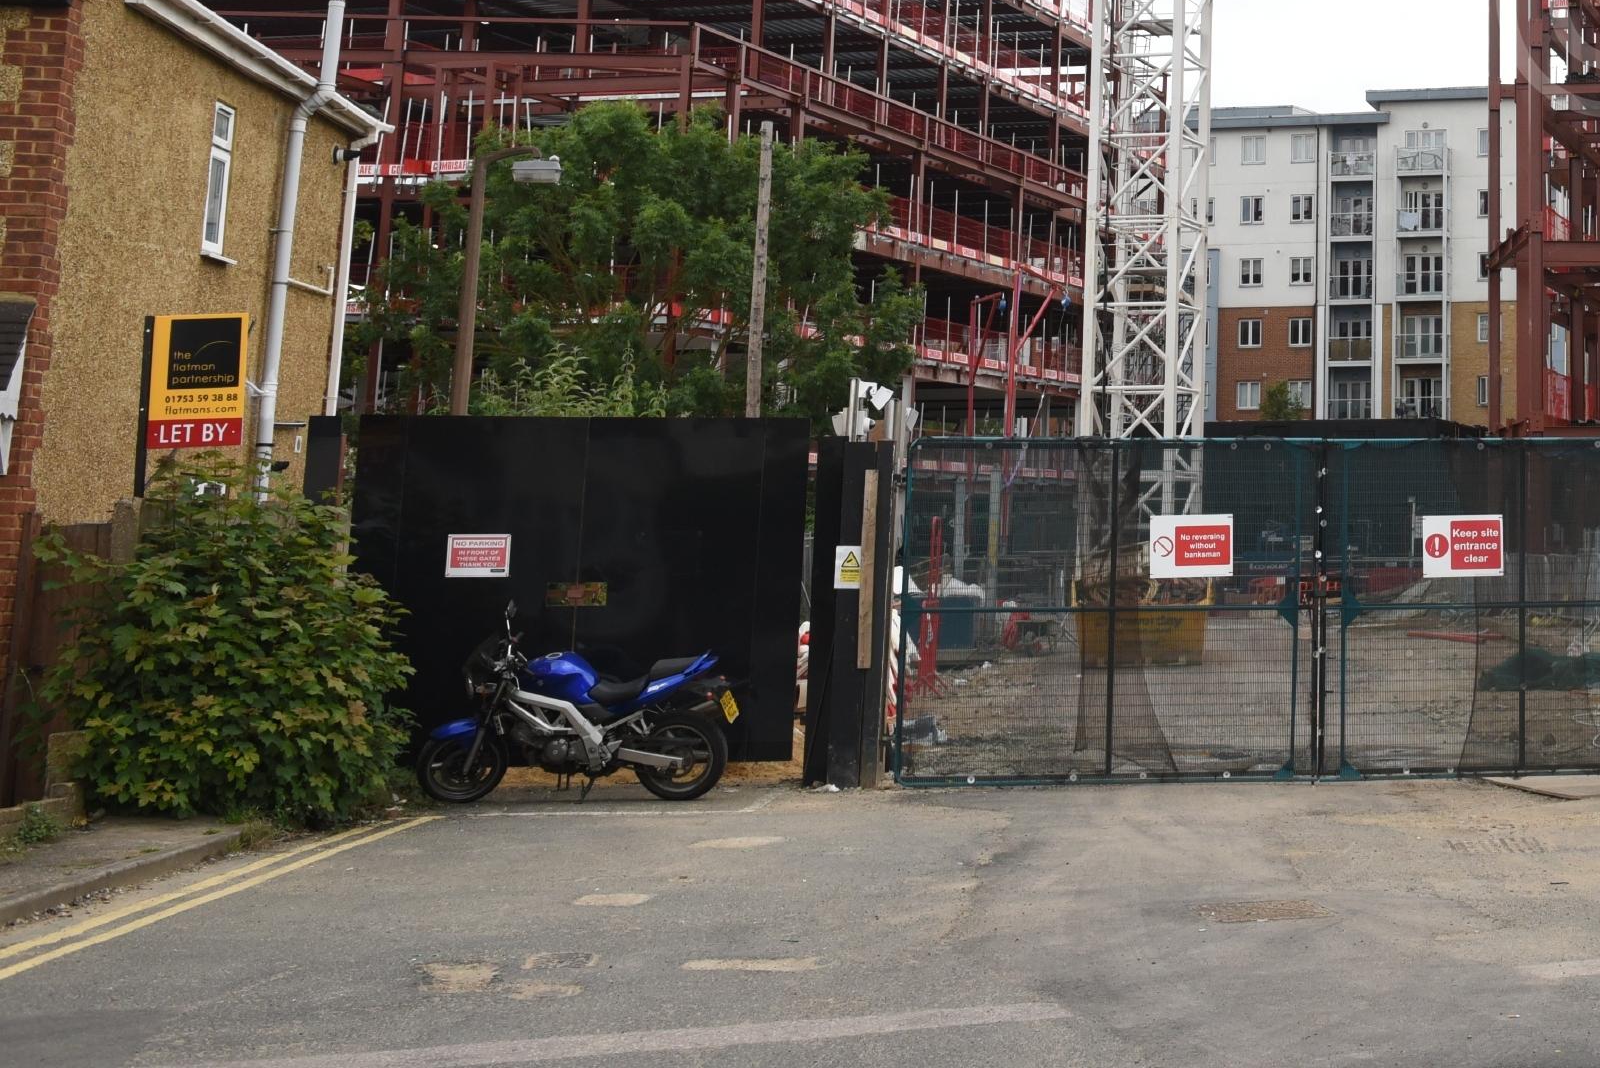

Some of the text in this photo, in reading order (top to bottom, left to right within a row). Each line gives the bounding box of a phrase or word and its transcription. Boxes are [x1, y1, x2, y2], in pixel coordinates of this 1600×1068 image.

[174, 351, 192, 360] the
[172, 363, 216, 372] flatman
[172, 374, 235, 385] partnership
[165, 393, 238, 404] 01753 59 38 88
[164, 405, 237, 415] flatmans.com
[160, 422, 228, 444] LET BY
[1452, 528, 1498, 539] Keep site
[1454, 542, 1498, 550] entrance
[1464, 554, 1488, 562] clear
